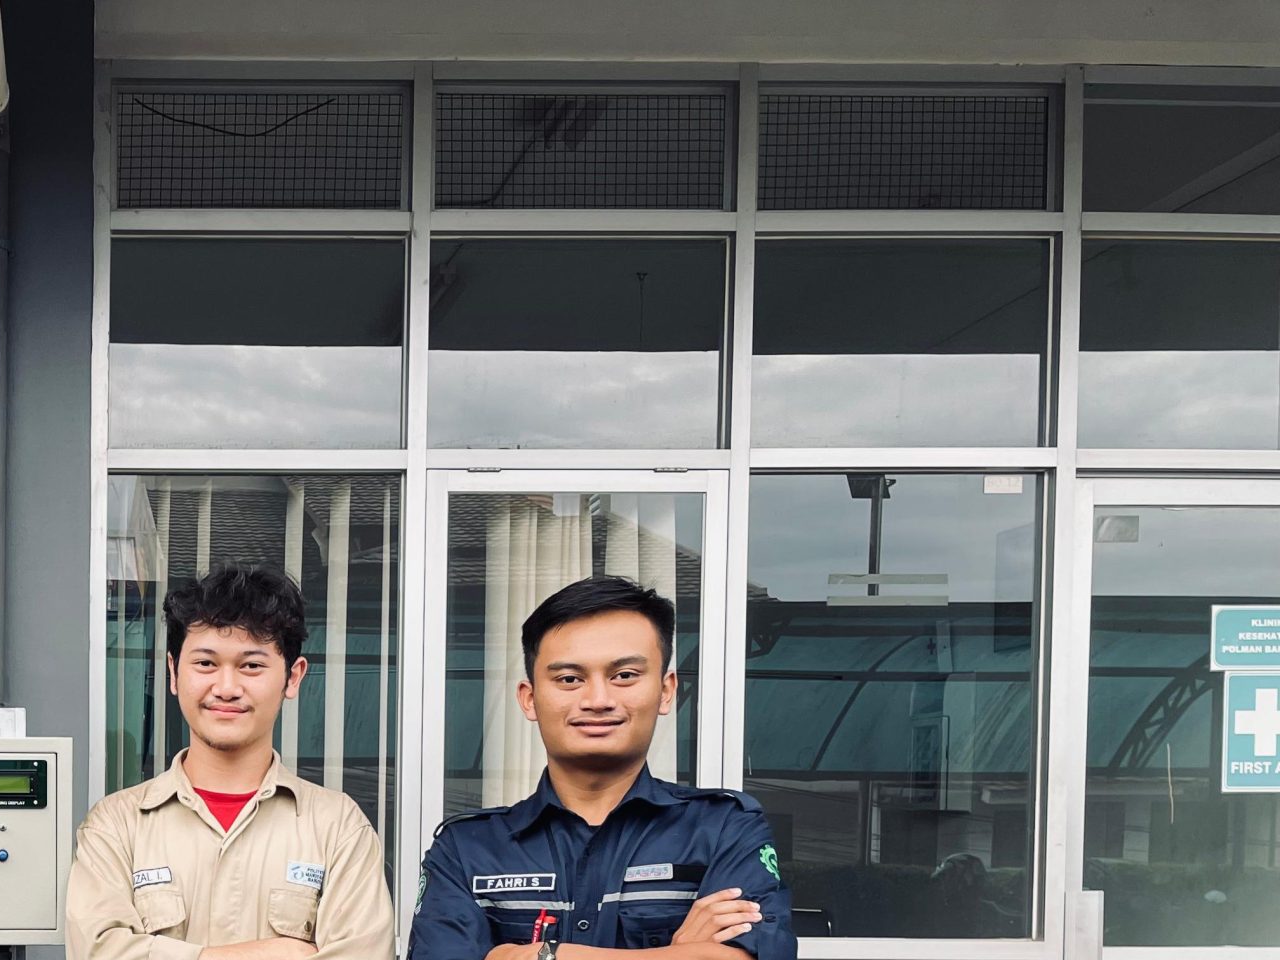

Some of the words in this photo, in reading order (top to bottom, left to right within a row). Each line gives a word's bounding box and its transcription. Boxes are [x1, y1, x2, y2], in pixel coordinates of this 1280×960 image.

[1222, 645, 1263, 653] POLMAN
[1231, 761, 1272, 774] FIRST
[487, 878, 527, 889] FAHRI
[531, 877, 540, 887] S
